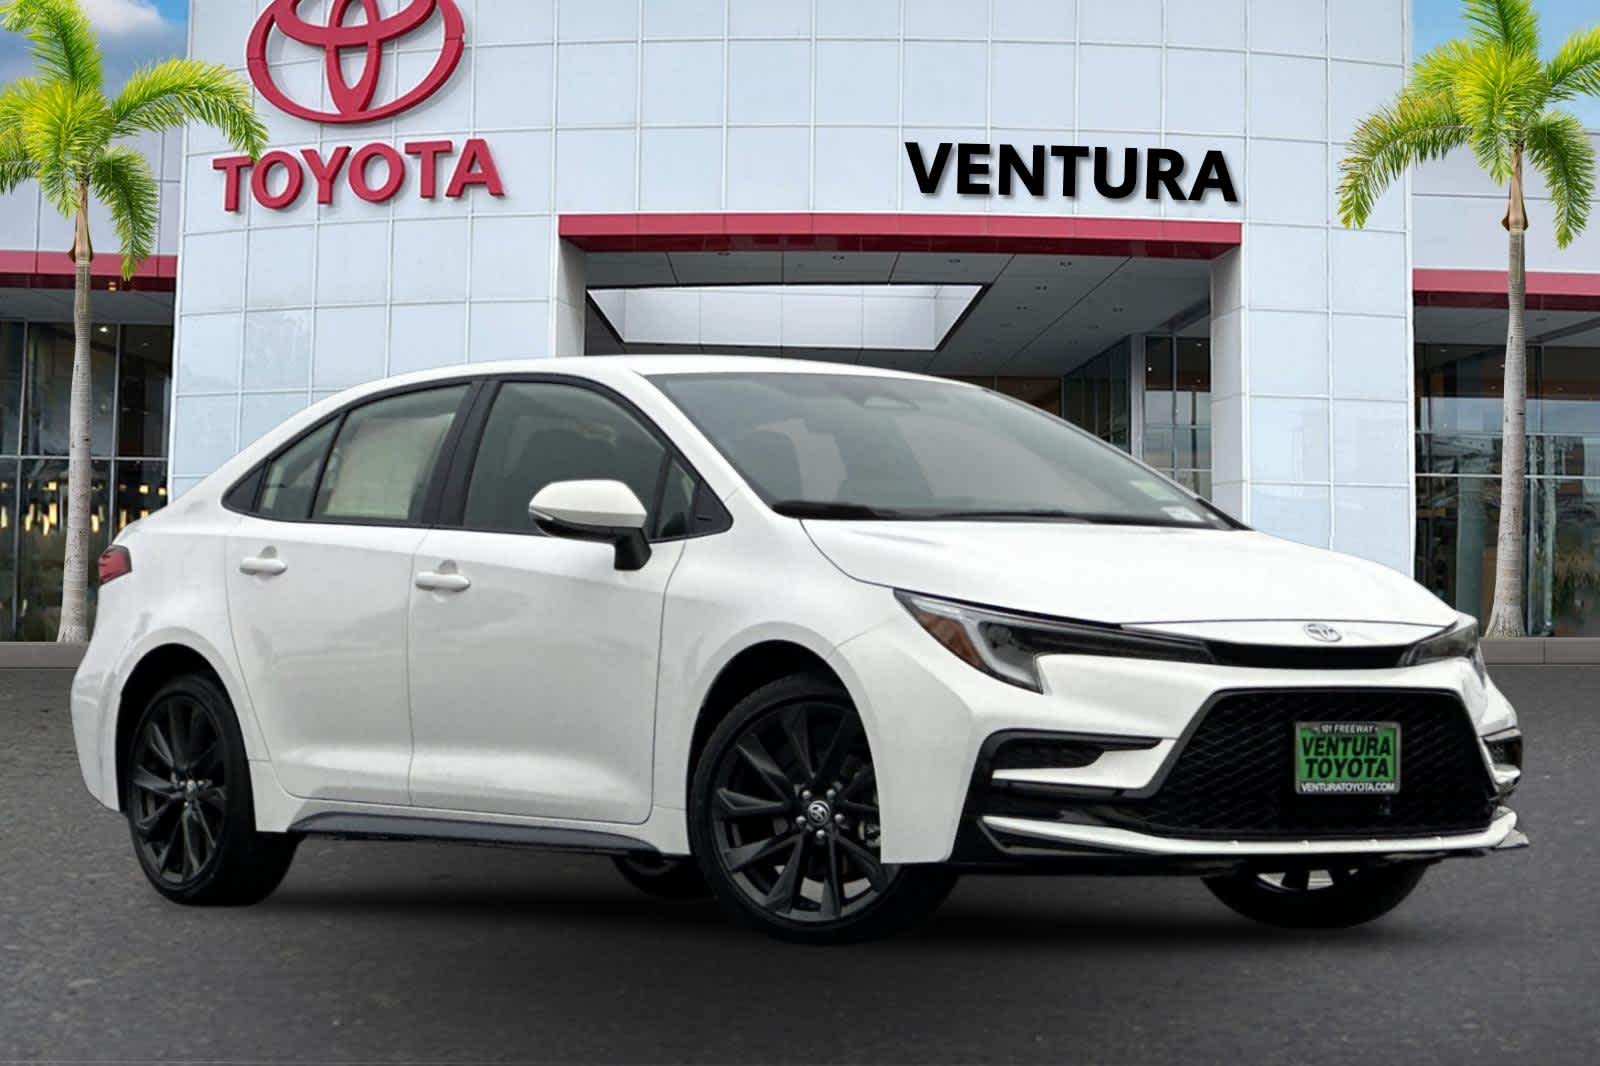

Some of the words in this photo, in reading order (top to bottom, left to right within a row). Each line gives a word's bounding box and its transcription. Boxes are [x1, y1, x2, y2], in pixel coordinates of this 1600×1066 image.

[212, 138, 505, 213] TOYOTA
[904, 142, 1238, 203] VENTURA
[1334, 724, 1373, 733] FREEWAY
[1302, 736, 1391, 756] VENTURA
[1305, 757, 1389, 778] TOYOTA
[1301, 782, 1395, 792] VENTURATOYOTA.COM
